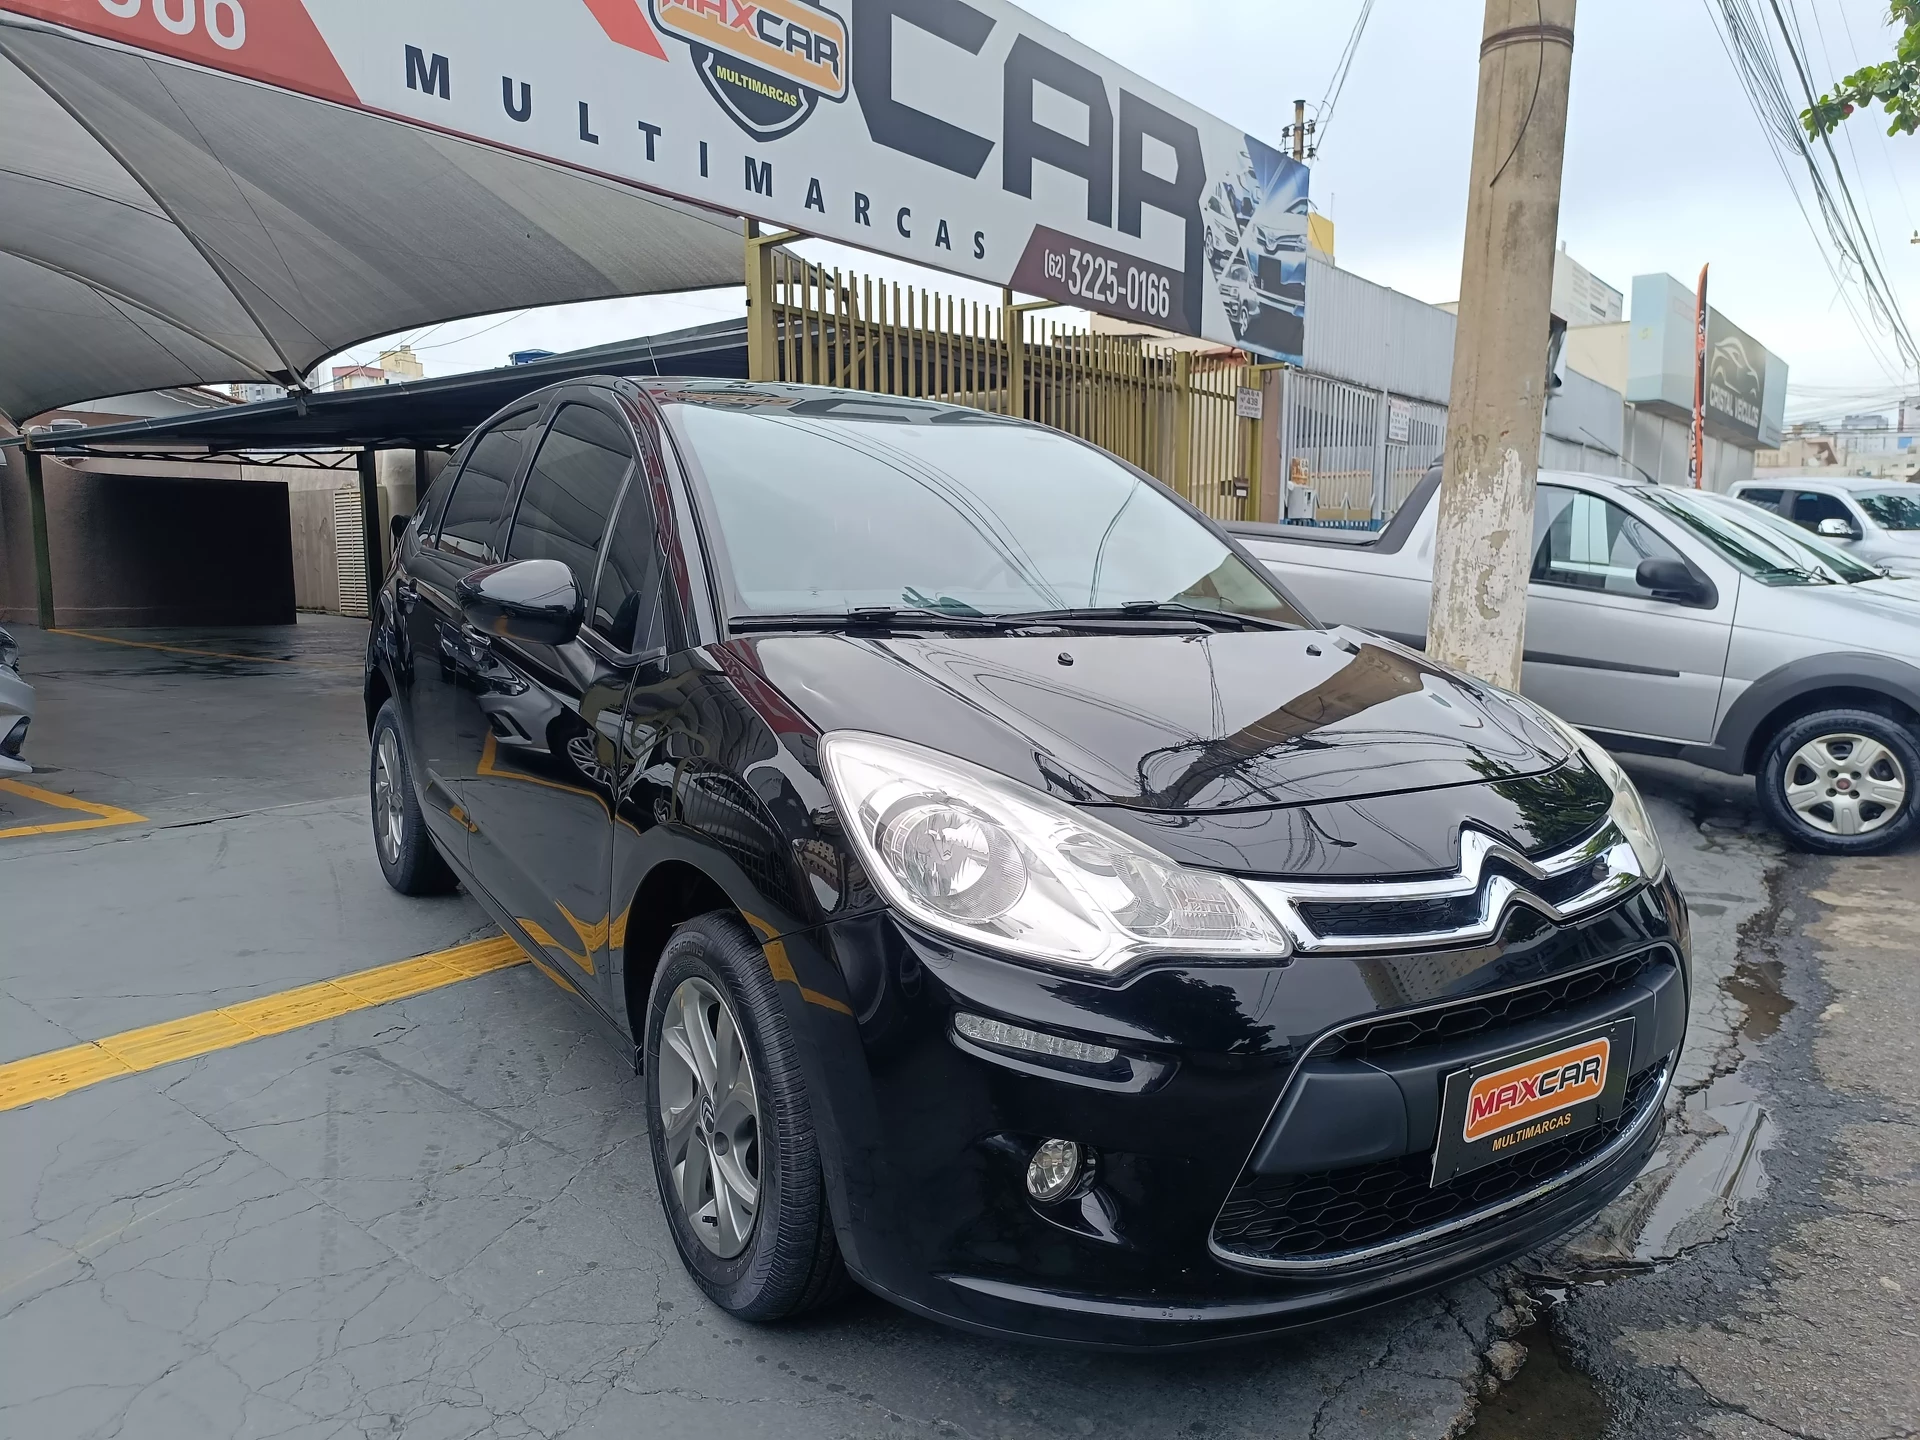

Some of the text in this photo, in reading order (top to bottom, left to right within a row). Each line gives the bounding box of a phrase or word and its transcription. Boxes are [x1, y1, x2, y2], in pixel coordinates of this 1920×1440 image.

[716, 64, 798, 107] MULTIMARCAS
[1044, 247, 1170, 319] (62) 3225-0166
[1709, 382, 1734, 418] CRISTAL
[1468, 1055, 1602, 1130] MAXCAR
[1492, 1113, 1572, 1152] MULTIMARCAS
